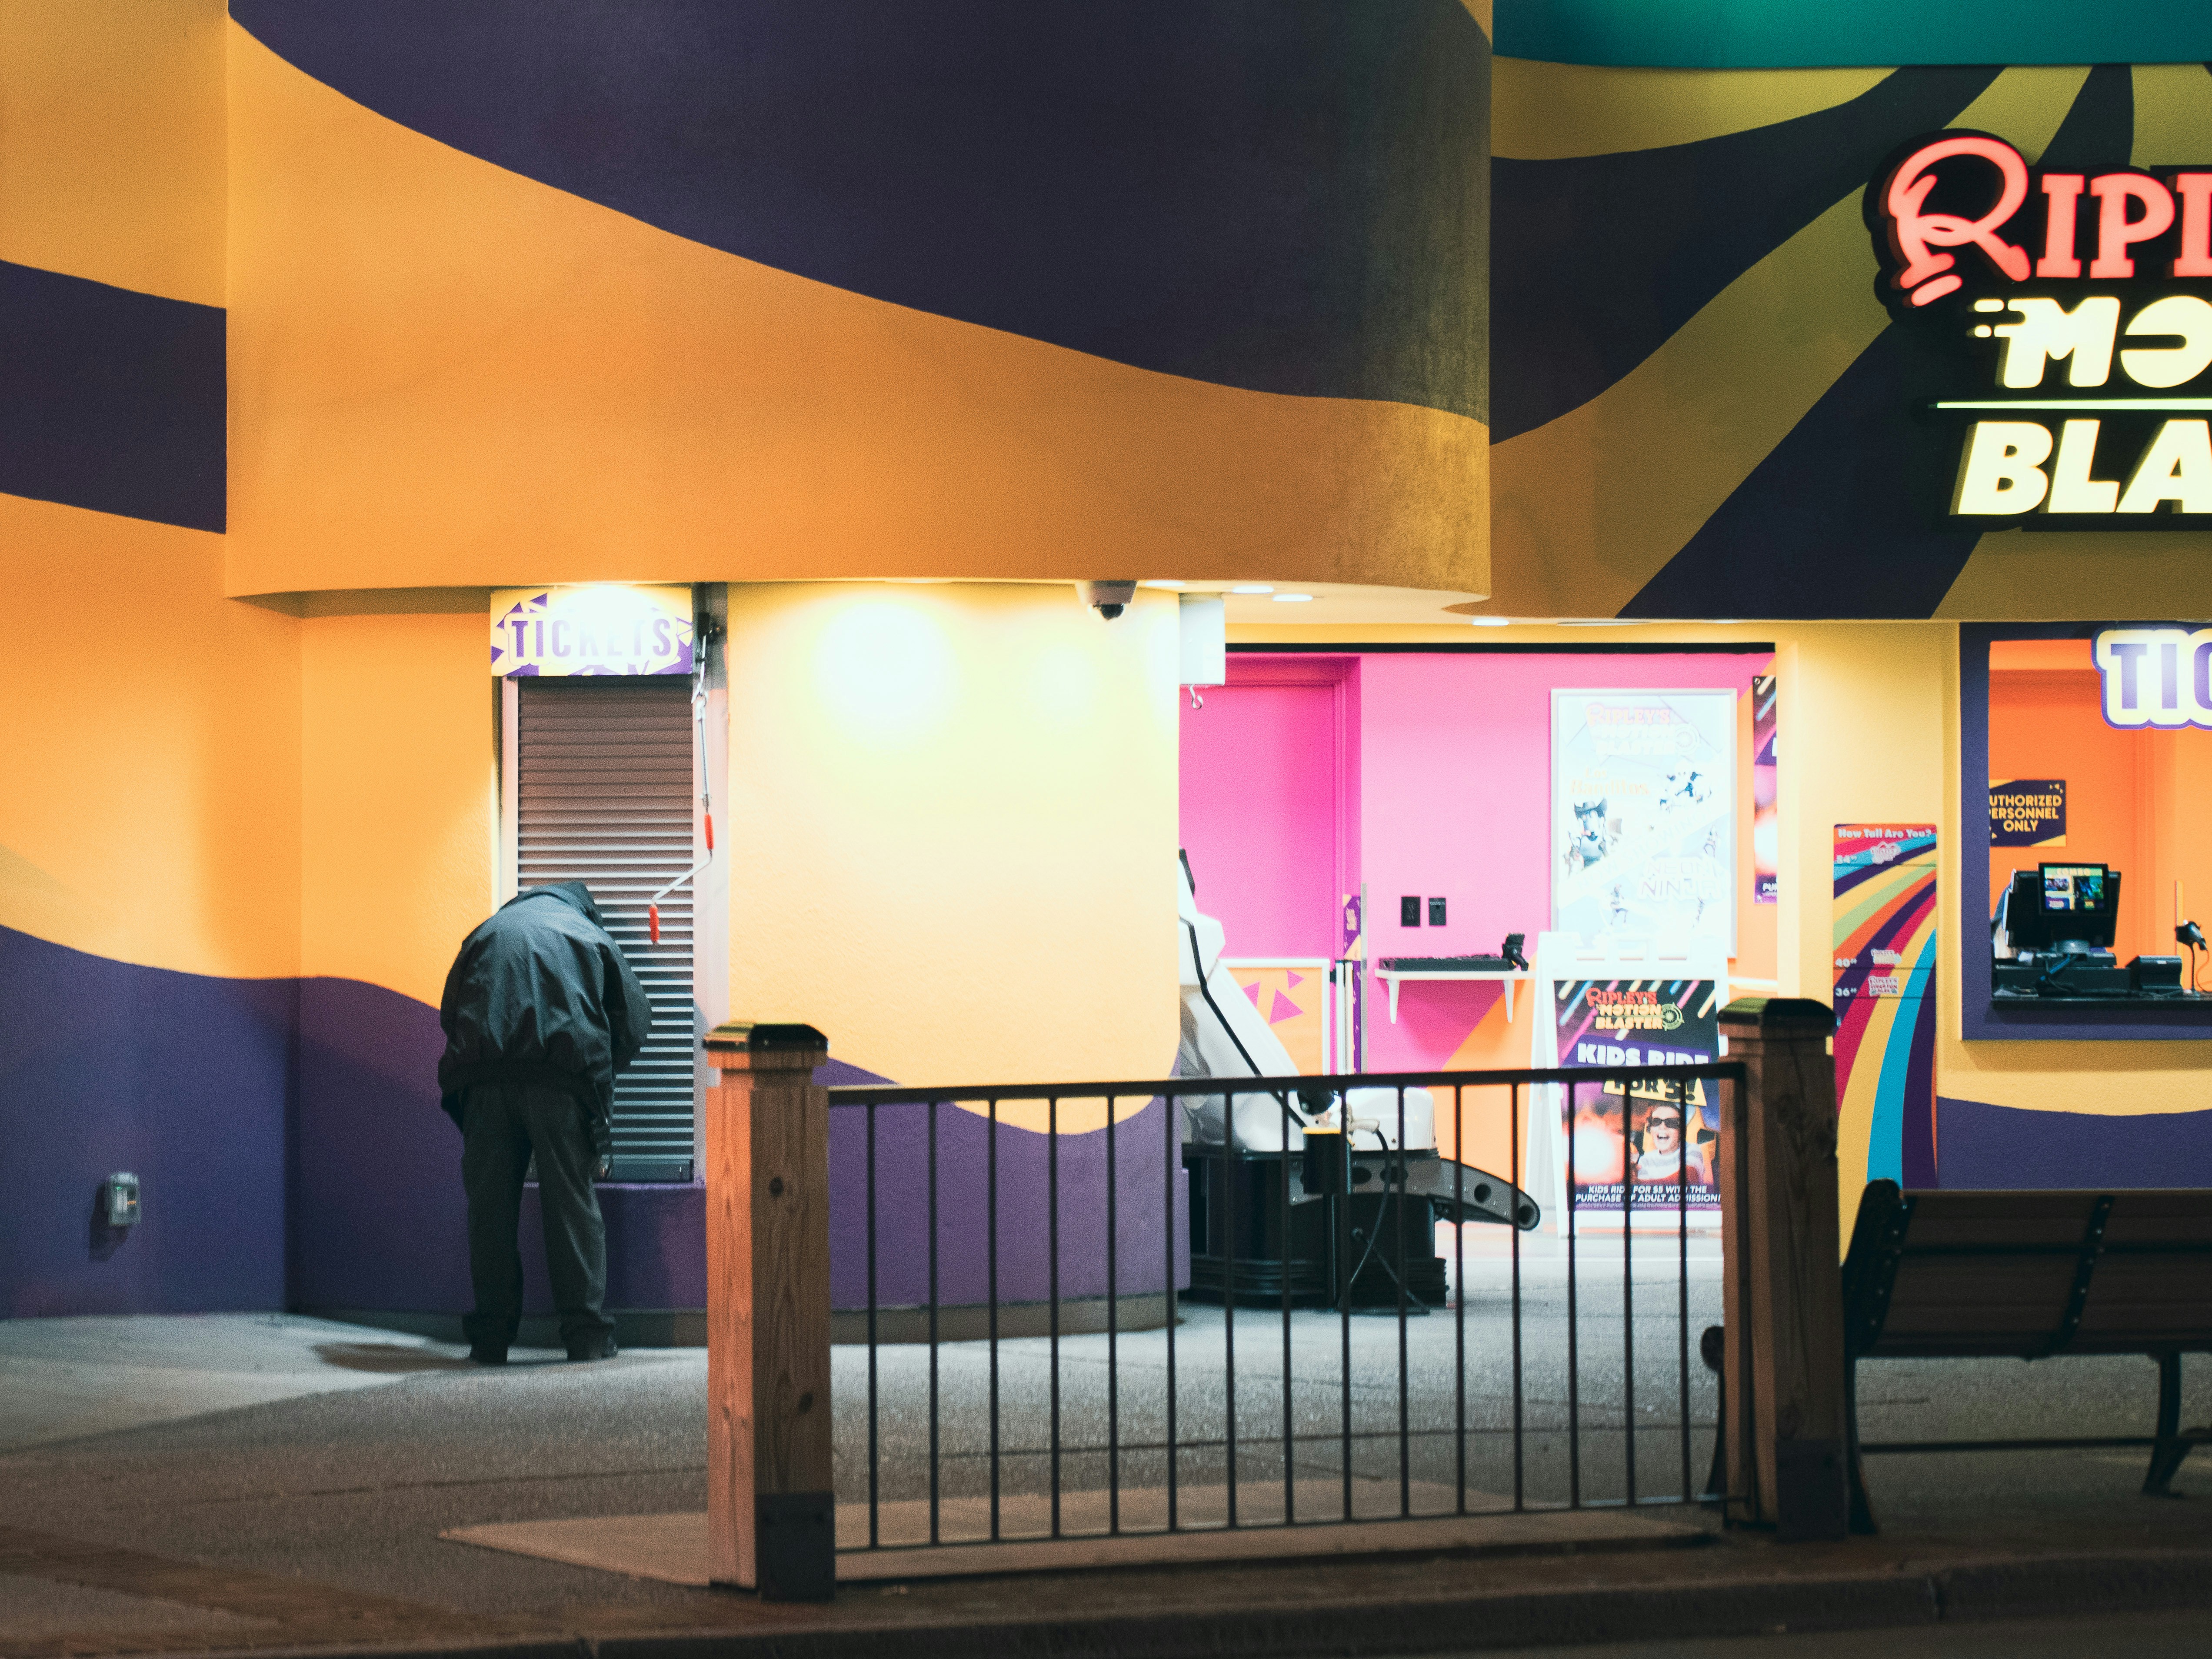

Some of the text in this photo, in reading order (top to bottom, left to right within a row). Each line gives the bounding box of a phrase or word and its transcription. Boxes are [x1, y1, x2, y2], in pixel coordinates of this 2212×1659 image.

[1956, 419, 2212, 515] BLA
[511, 619, 672, 658] TICKETS
[1586, 704, 1670, 726] RIPLEY'S
[1585, 766, 1607, 778] Los
[1570, 779, 1650, 796] Banditos
[1989, 795, 2062, 807] UTHORIZED
[1989, 807, 2059, 820] ERSONNEL
[2003, 820, 2039, 832] ONLY
[1838, 828, 1932, 838] How Tall Are You?
[1647, 861, 1717, 877] NEON
[1641, 879, 1719, 896] NINJA
[1835, 958, 1857, 968] 40"
[1586, 987, 1657, 1006] RIPLEY'S
[1835, 987, 1857, 997] 36"
[1596, 1004, 1662, 1016] MOTION
[1595, 1016, 1663, 1029] BLASTER
[1578, 1043, 1641, 1066] KIDS
[1589, 1185, 1609, 1194] KIDS
[1611, 1185, 1625, 1194] RID
[1633, 1185, 1651, 1194] FOR
[1690, 1185, 1707, 1194] THE
[1576, 1193, 1622, 1203] PURCHASE
[1638, 1194, 1666, 1203] ADULT
